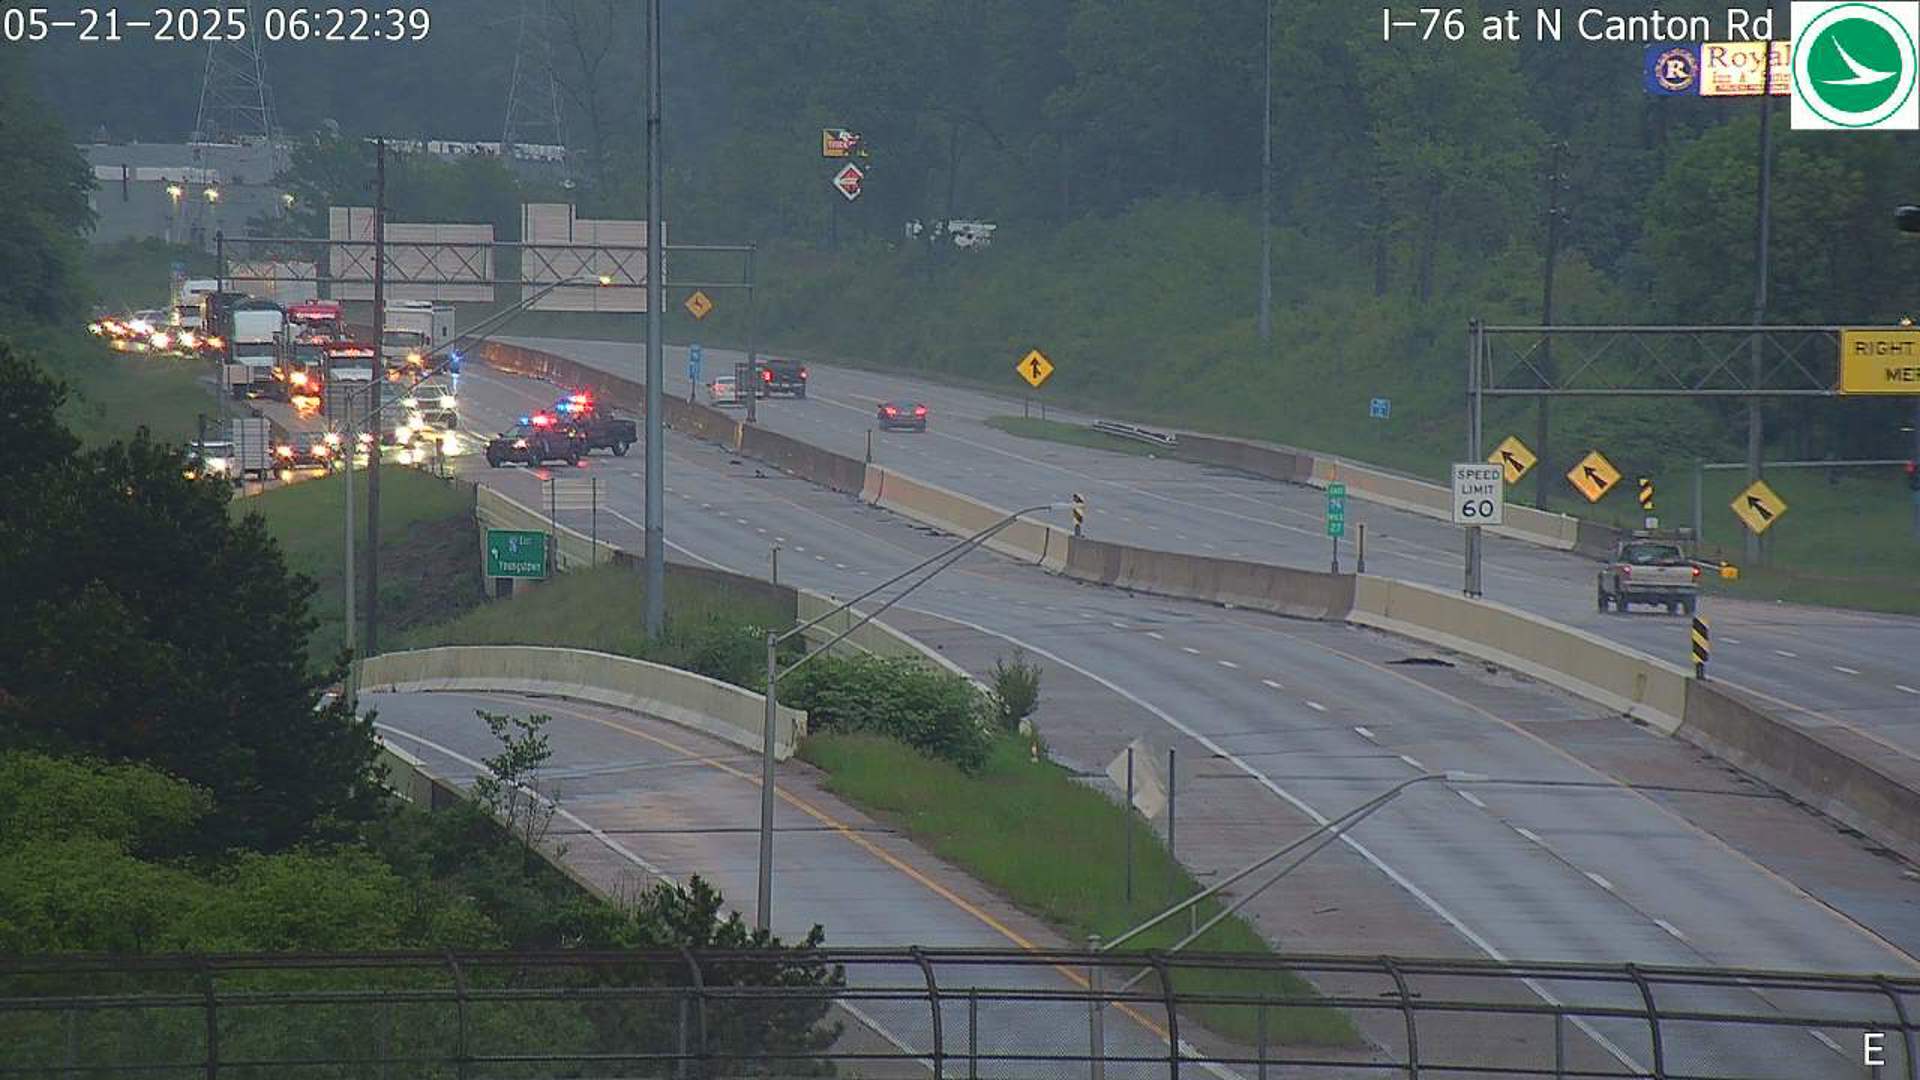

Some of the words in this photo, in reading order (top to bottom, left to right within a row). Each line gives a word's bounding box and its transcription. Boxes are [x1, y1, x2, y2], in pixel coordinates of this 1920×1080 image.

[1707, 44, 1791, 73] Royal
[1855, 340, 1914, 356] RIGHT
[1457, 469, 1501, 481] SPEED
[1461, 484, 1494, 495] LIMIT
[1462, 499, 1494, 518] 60
